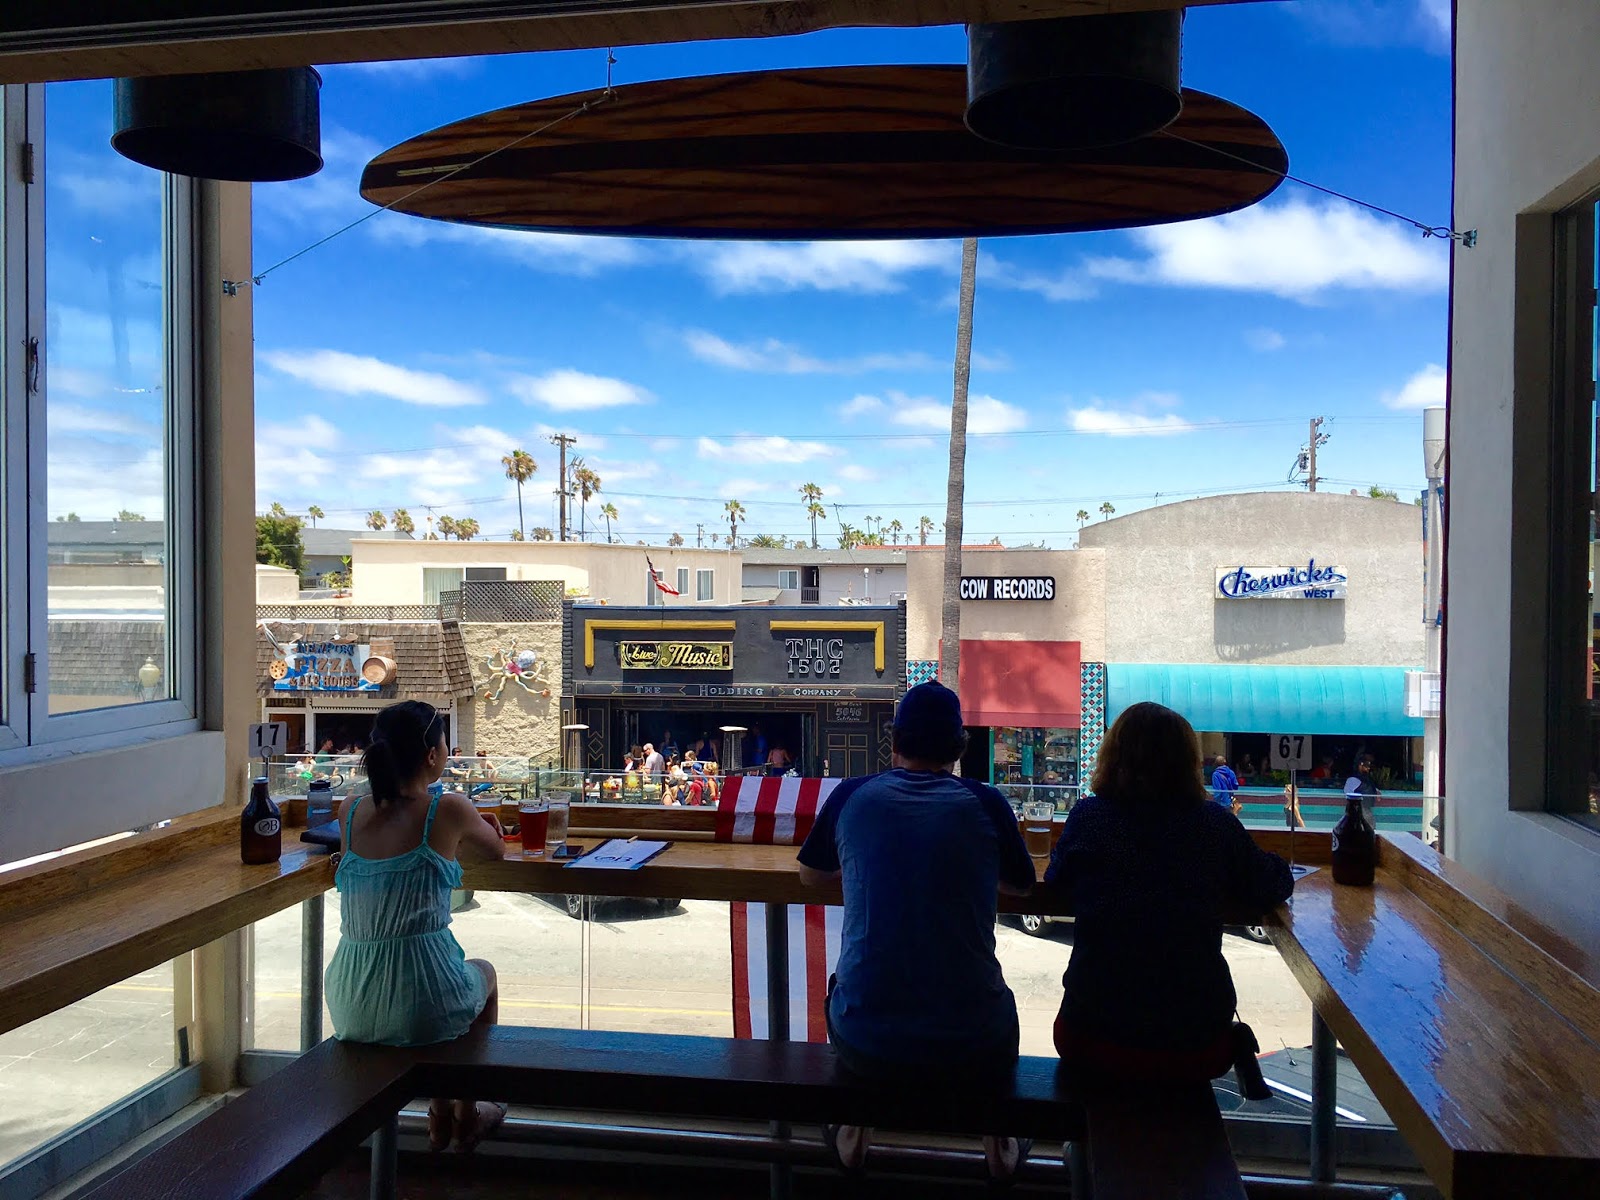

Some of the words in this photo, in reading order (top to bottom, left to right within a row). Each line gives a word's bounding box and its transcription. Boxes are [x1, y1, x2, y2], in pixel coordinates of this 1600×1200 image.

[1219, 558, 1346, 598] Cheswicks
[960, 579, 988, 599] COW
[994, 579, 1054, 599] RECORDS
[1303, 589, 1335, 599] WEST
[296, 641, 355, 656] NEWPORT
[631, 645, 655, 660] Live
[660, 644, 721, 667] Music
[785, 638, 844, 659] THC
[294, 658, 357, 673] PIZZA
[787, 659, 841, 674] 1502
[289, 676, 297, 687] &
[300, 675, 320, 687] ALE
[323, 675, 360, 687] HOUSE
[634, 685, 661, 694] THE
[699, 685, 764, 697] HOLDING
[255, 724, 280, 747] 17
[1279, 735, 1305, 759] 67
